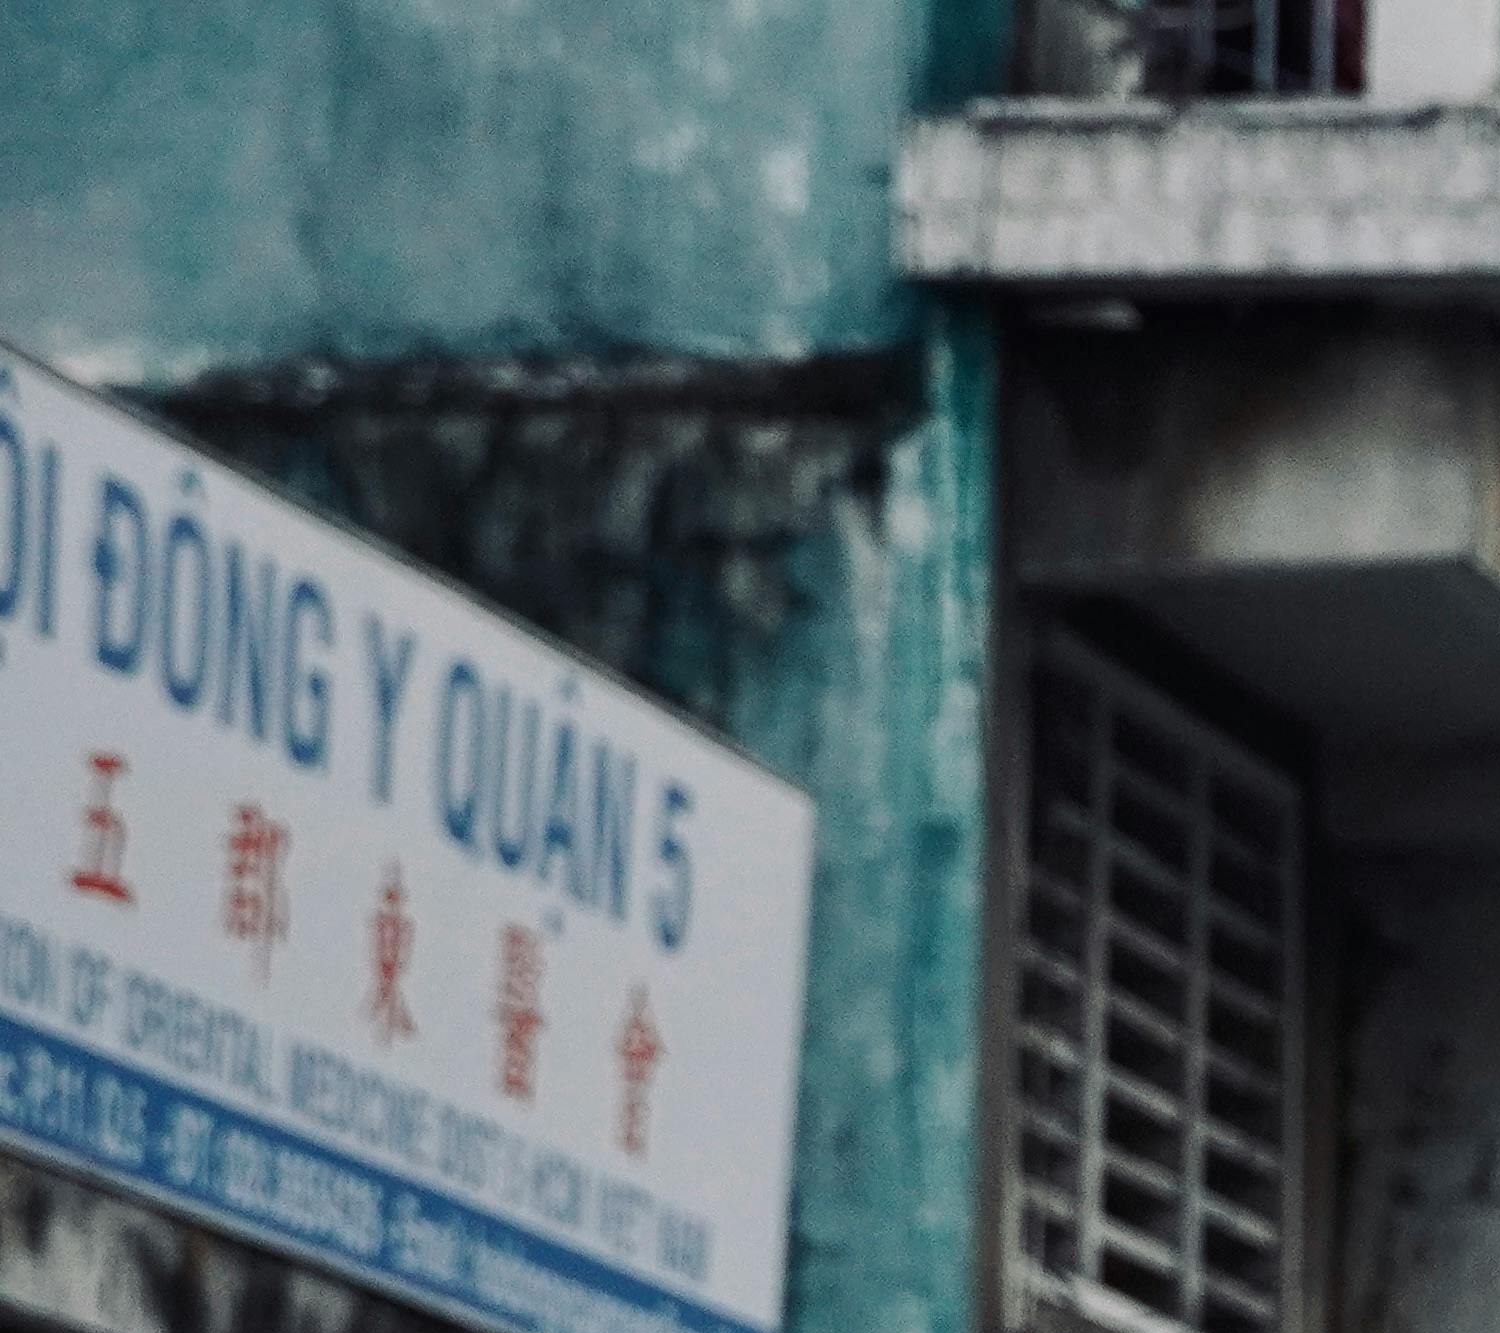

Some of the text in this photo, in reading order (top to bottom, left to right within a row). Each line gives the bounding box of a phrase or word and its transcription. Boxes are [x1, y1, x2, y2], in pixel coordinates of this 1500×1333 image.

[90, 464, 336, 772] ĐÔNG
[362, 606, 417, 808] Y
[435, 655, 638, 942] QUẬN
[648, 776, 696, 957] 5
